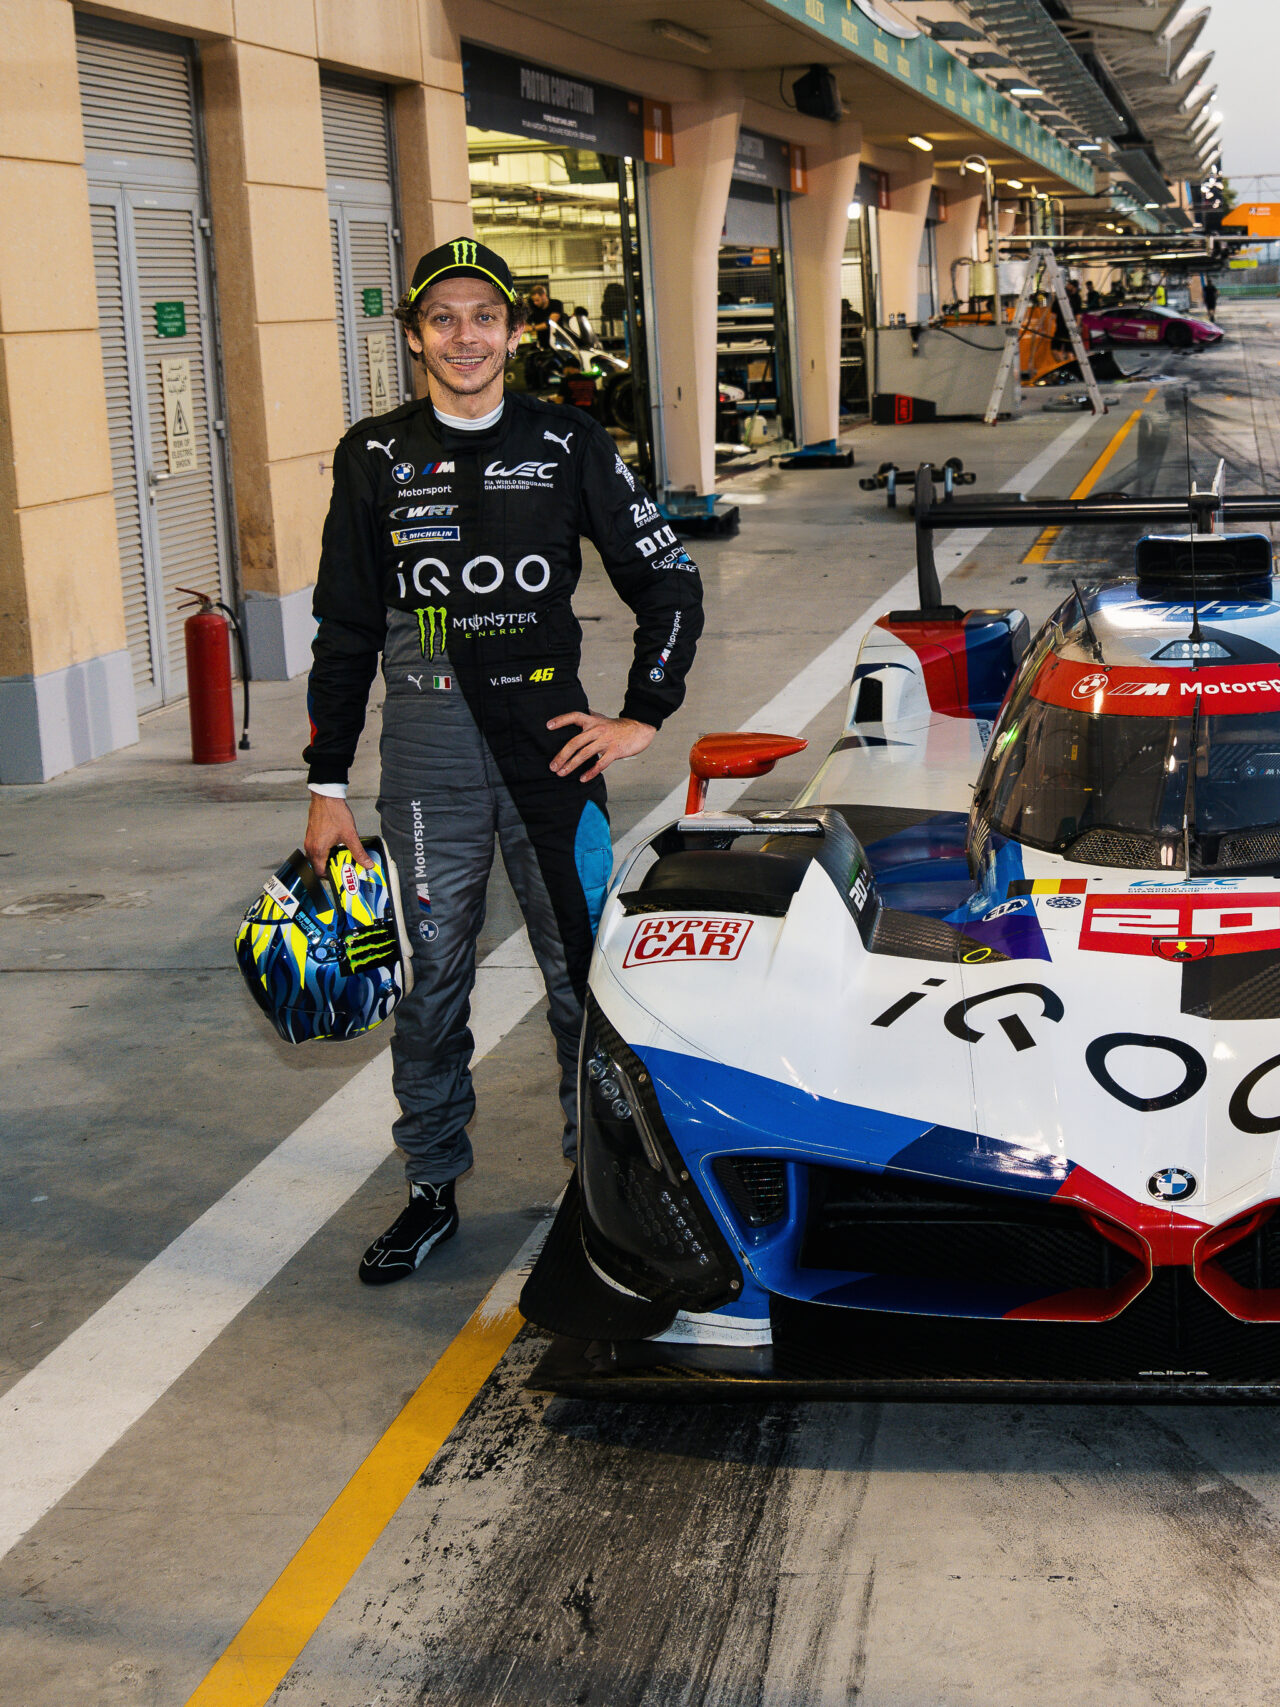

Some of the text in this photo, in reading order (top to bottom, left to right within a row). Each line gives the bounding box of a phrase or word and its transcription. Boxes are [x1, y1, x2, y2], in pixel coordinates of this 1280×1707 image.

[484, 461, 559, 479] WEC
[398, 486, 452, 498] Motorsport
[407, 505, 459, 518] WRT
[629, 497, 657, 524] 24h
[409, 531, 453, 539] MICHELIN
[397, 554, 550, 598] iQOO
[465, 627, 526, 639] ENERGY
[490, 674, 523, 686] V. Rossi
[528, 667, 555, 682] 46
[411, 800, 425, 878] Motorsport
[347, 866, 357, 892] BELL
[1129, 878, 1248, 887] WEC
[849, 877, 868, 912] 20
[986, 899, 1027, 921] FIA
[641, 919, 742, 936] HYPER
[1090, 906, 1280, 936] 20
[634, 933, 736, 960] CAR
